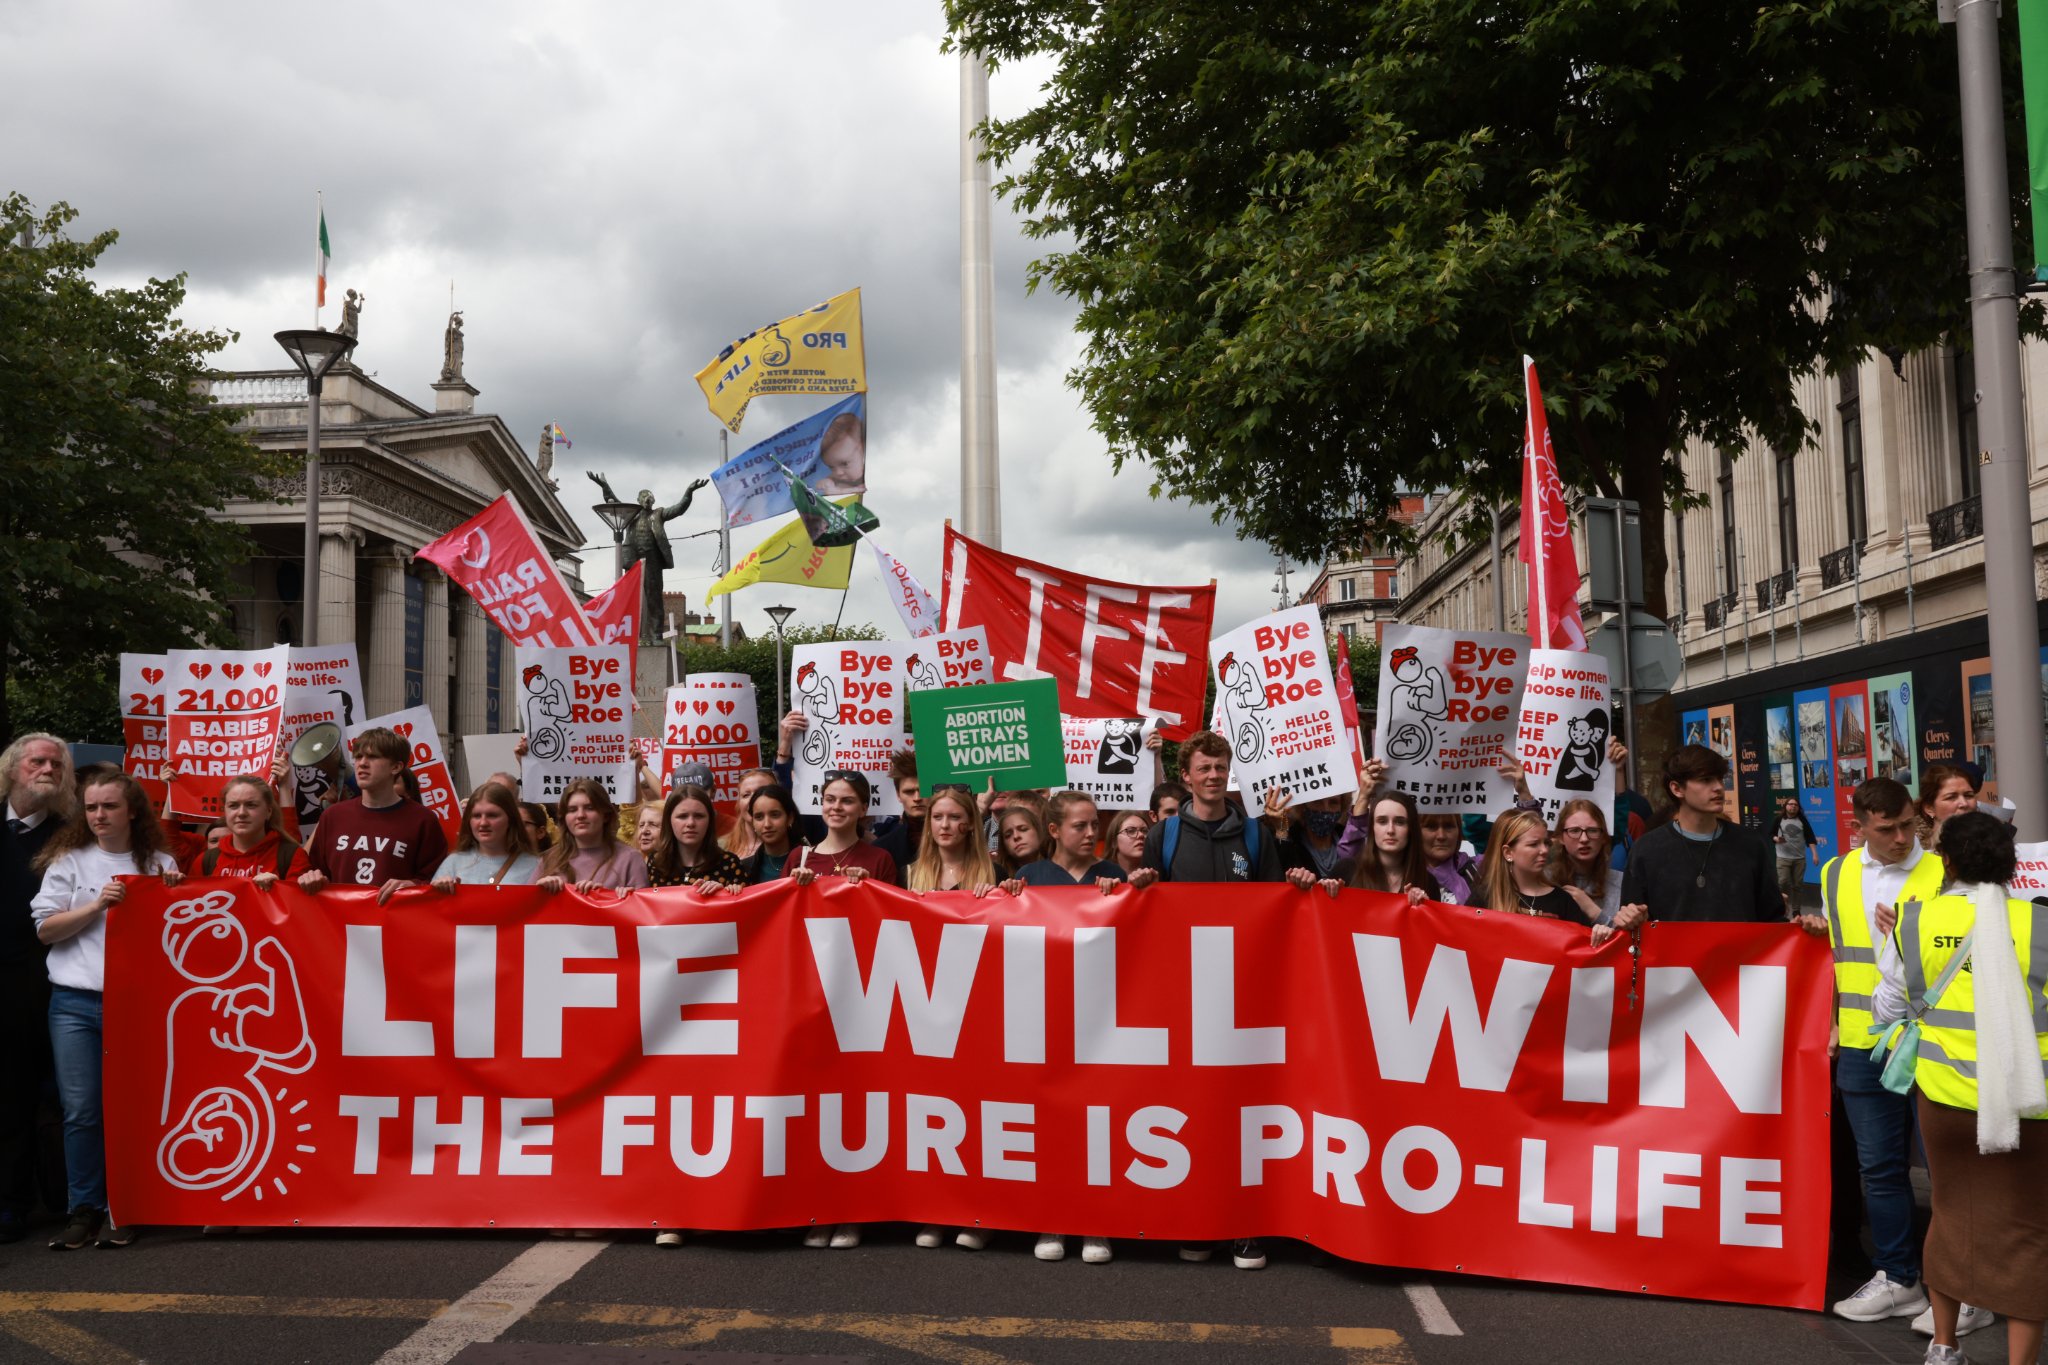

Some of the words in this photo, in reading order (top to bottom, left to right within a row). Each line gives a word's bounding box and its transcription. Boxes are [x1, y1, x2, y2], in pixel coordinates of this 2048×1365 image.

[1254, 621, 1310, 652] Bye
[937, 638, 980, 658] Bye
[1452, 640, 1517, 671] Bye
[293, 657, 349, 672] women
[569, 655, 620, 680] Bye
[840, 650, 892, 677] Bye
[944, 658, 984, 681] bye
[1263, 650, 1317, 680] bye
[1529, 663, 1556, 681] elp
[1562, 668, 1608, 685] women
[311, 673, 342, 687] life.
[843, 677, 893, 705] bye
[1455, 676, 1514, 701] bye
[177, 684, 279, 715] 21,000
[574, 680, 622, 705] bye
[1264, 678, 1323, 709] Roe
[1580, 686, 1604, 702] life.
[572, 703, 623, 724] Roe
[839, 703, 893, 725] Roe
[945, 706, 1026, 729] ABORTION
[1285, 710, 1330, 730] HELLO
[1447, 698, 1510, 724] Roe
[1522, 709, 1559, 726] EEP
[190, 716, 269, 738] BABIES
[667, 723, 749, 749] 21,000
[946, 725, 1029, 747] BETRAYS
[1270, 722, 1333, 746] PRO-LIFE
[1518, 726, 1545, 741] HE
[1926, 729, 1950, 744] Clerys
[175, 732, 274, 758] ABORTED
[570, 745, 625, 754] PRO-LIFE
[586, 734, 625, 743] HELLO
[852, 738, 893, 748] HELLO
[1276, 736, 1336, 758] FUTURE!
[1460, 733, 1505, 746] HELLO
[574, 754, 626, 764] FUTURE!
[836, 750, 893, 760] PRO-LIFE
[949, 742, 1030, 768] WOMEN
[1439, 744, 1504, 758] PRO-LIFE
[1517, 743, 1563, 760] -DAY
[1923, 747, 1955, 763] Quarter
[177, 751, 271, 777] ALREADY
[1441, 757, 1503, 770] FUTURE!
[1521, 760, 1552, 776] AIT
[543, 775, 615, 785] RETNK
[1068, 782, 1134, 792] RETHINK
[1252, 763, 1329, 793] RETHINK
[1396, 780, 1486, 794] RETHINK
[1094, 793, 1134, 803] RTION
[1256, 776, 1333, 806] ARTION
[1410, 794, 1487, 806] BORTION
[336, 834, 408, 859] SAVE
[341, 921, 739, 1059] LIFE
[804, 917, 1286, 1067] WILL
[1352, 932, 1787, 1114] WIN
[338, 1094, 554, 1176] THE
[600, 1091, 1037, 1183] FUTURE
[1086, 1105, 1192, 1190] IS
[1240, 1104, 1783, 1248] PRO-LIFE
